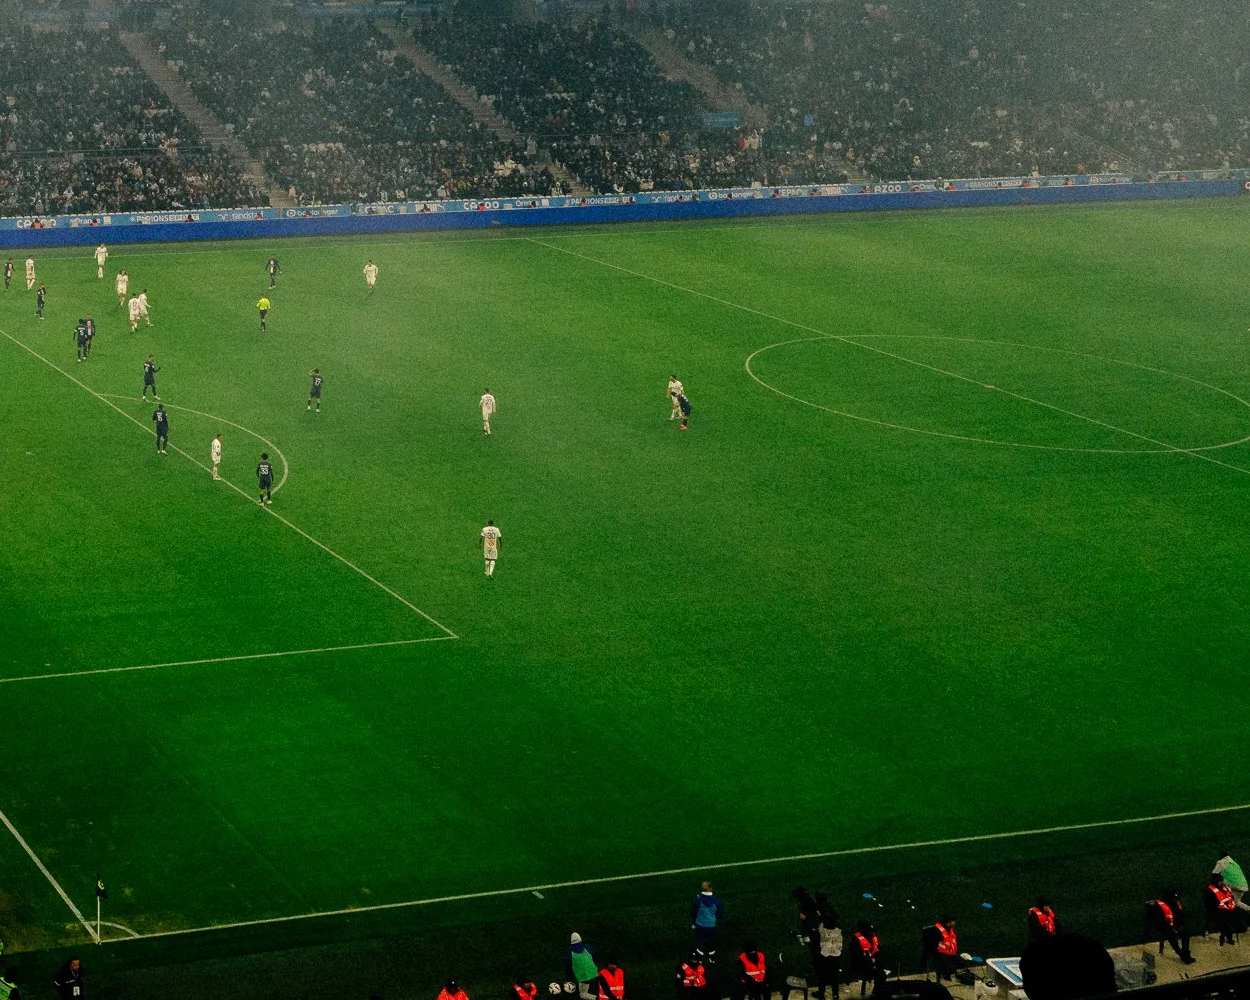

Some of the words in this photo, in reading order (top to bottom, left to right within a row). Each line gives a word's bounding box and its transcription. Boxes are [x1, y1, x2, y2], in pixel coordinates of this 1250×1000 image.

[874, 184, 902, 193] AZOO
[260, 467, 269, 475] 33
[487, 532, 496, 540] 30
